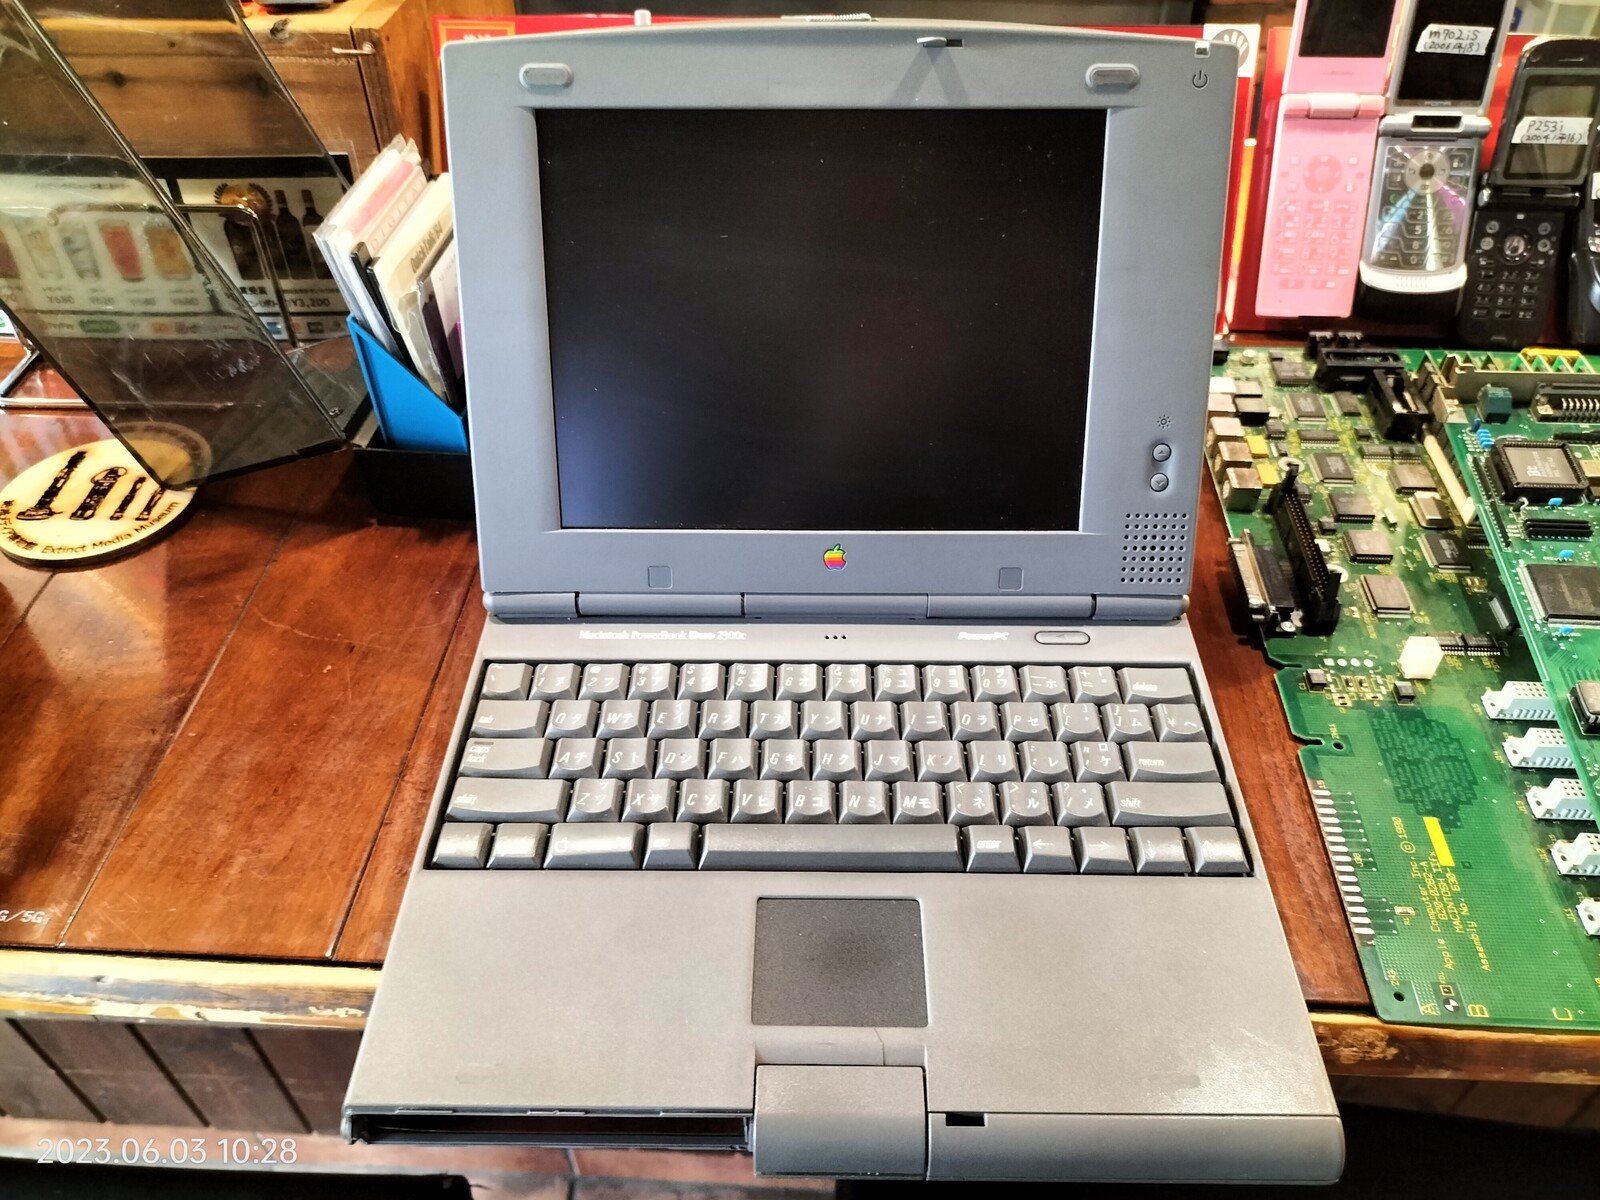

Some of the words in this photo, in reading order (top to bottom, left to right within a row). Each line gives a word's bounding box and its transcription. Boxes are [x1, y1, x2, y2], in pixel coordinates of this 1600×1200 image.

[1527, 120, 1564, 132] P253i
[1414, 226, 1421, 234] 5
[41, 545, 88, 554] Extinct
[92, 533, 132, 549] Media
[134, 502, 179, 533] Museum
[579, 630, 629, 640] Macintosh
[834, 667, 842, 676] &
[538, 677, 545, 687] 1
[587, 677, 597, 687] 2
[604, 677, 615, 687] フ
[637, 677, 647, 686] 3
[686, 677, 694, 687] 4
[736, 677, 744, 686] 5
[785, 677, 793, 686] 6
[835, 677, 843, 687] 7
[884, 678, 891, 687] 8
[933, 679, 941, 688] 9
[983, 678, 990, 688] 0
[1046, 679, 1057, 689] ホ
[606, 712, 620, 724] W
[622, 712, 634, 724] テ
[656, 712, 668, 724] E
[708, 712, 718, 724] R
[759, 713, 769, 724] T
[773, 713, 785, 724] カ
[810, 713, 819, 724] Y
[860, 714, 870, 725] U
[875, 715, 886, 725] ナ
[926, 715, 937, 724] ニ
[977, 715, 988, 725] ラ
[1013, 715, 1022, 725] P
[1028, 717, 1040, 726] セ
[1132, 717, 1142, 727] ム
[559, 752, 569, 763] A
[612, 751, 623, 763] S
[631, 752, 639, 763] ト
[664, 752, 675, 764] D
[717, 752, 727, 763] F
[732, 755, 744, 764] ハ
[770, 753, 780, 765] G
[785, 753, 797, 765] キ
[822, 753, 833, 765] H
[838, 755, 849, 765] ク
[874, 754, 883, 765] J
[889, 756, 901, 766] マ
[927, 755, 937, 765] K
[980, 755, 986, 766] L
[997, 755, 1006, 766] リ
[1048, 757, 1059, 767] レ
[1100, 756, 1111, 767] ケ
[1138, 758, 1165, 766] return
[1064, 783, 1070, 793] ?
[577, 792, 590, 805] Z
[632, 793, 645, 805] X
[687, 794, 698, 806] C
[742, 794, 752, 806] V
[795, 795, 805, 806] B
[812, 797, 823, 807] コ
[849, 796, 861, 808] N
[867, 797, 877, 808] ミ
[902, 796, 917, 808] M
[918, 797, 931, 809] モ
[973, 796, 985, 809] ネ
[1027, 798, 1040, 808] ル
[1084, 798, 1093, 809] メ
[1120, 798, 1142, 808] shift
[1410, 856, 1422, 878] Inc.
[1418, 884, 1440, 932] Computer
[1436, 878, 1465, 934] MACINTOSH
[1459, 898, 1470, 916] No.
[1466, 920, 1492, 972] Assembly
[1437, 938, 1454, 970] Apple
[1421, 1003, 1438, 1015] A
[1468, 1004, 1490, 1018] B
[1552, 1007, 1573, 1020] C
